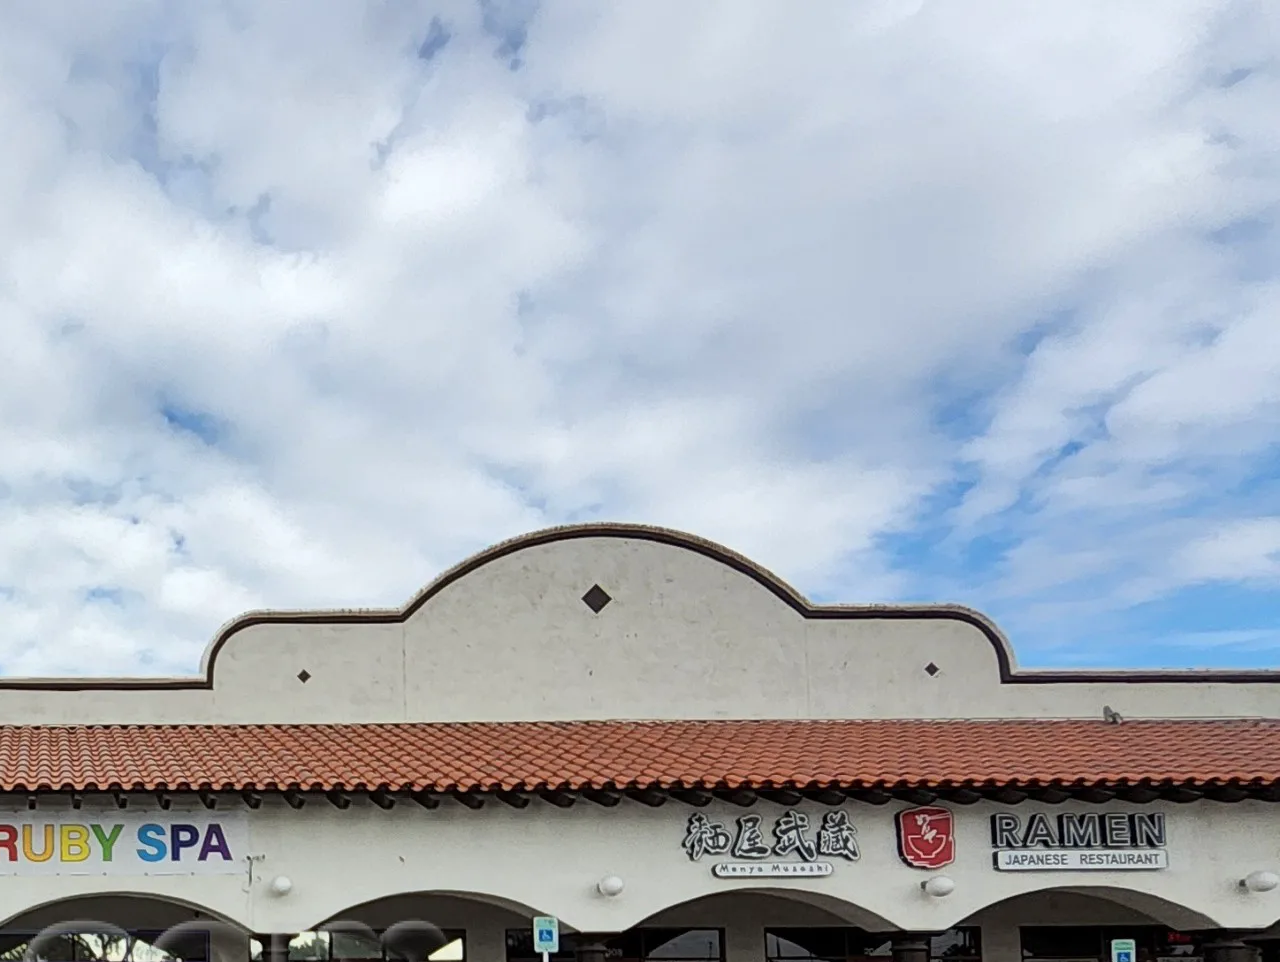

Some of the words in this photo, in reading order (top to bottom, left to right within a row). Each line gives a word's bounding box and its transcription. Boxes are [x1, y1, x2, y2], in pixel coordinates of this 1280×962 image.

[136, 822, 233, 863] SPA
[993, 812, 1167, 848] RAMEN
[1004, 853, 1068, 866] JAPANESE
[1079, 852, 1160, 866] RESTAURANT
